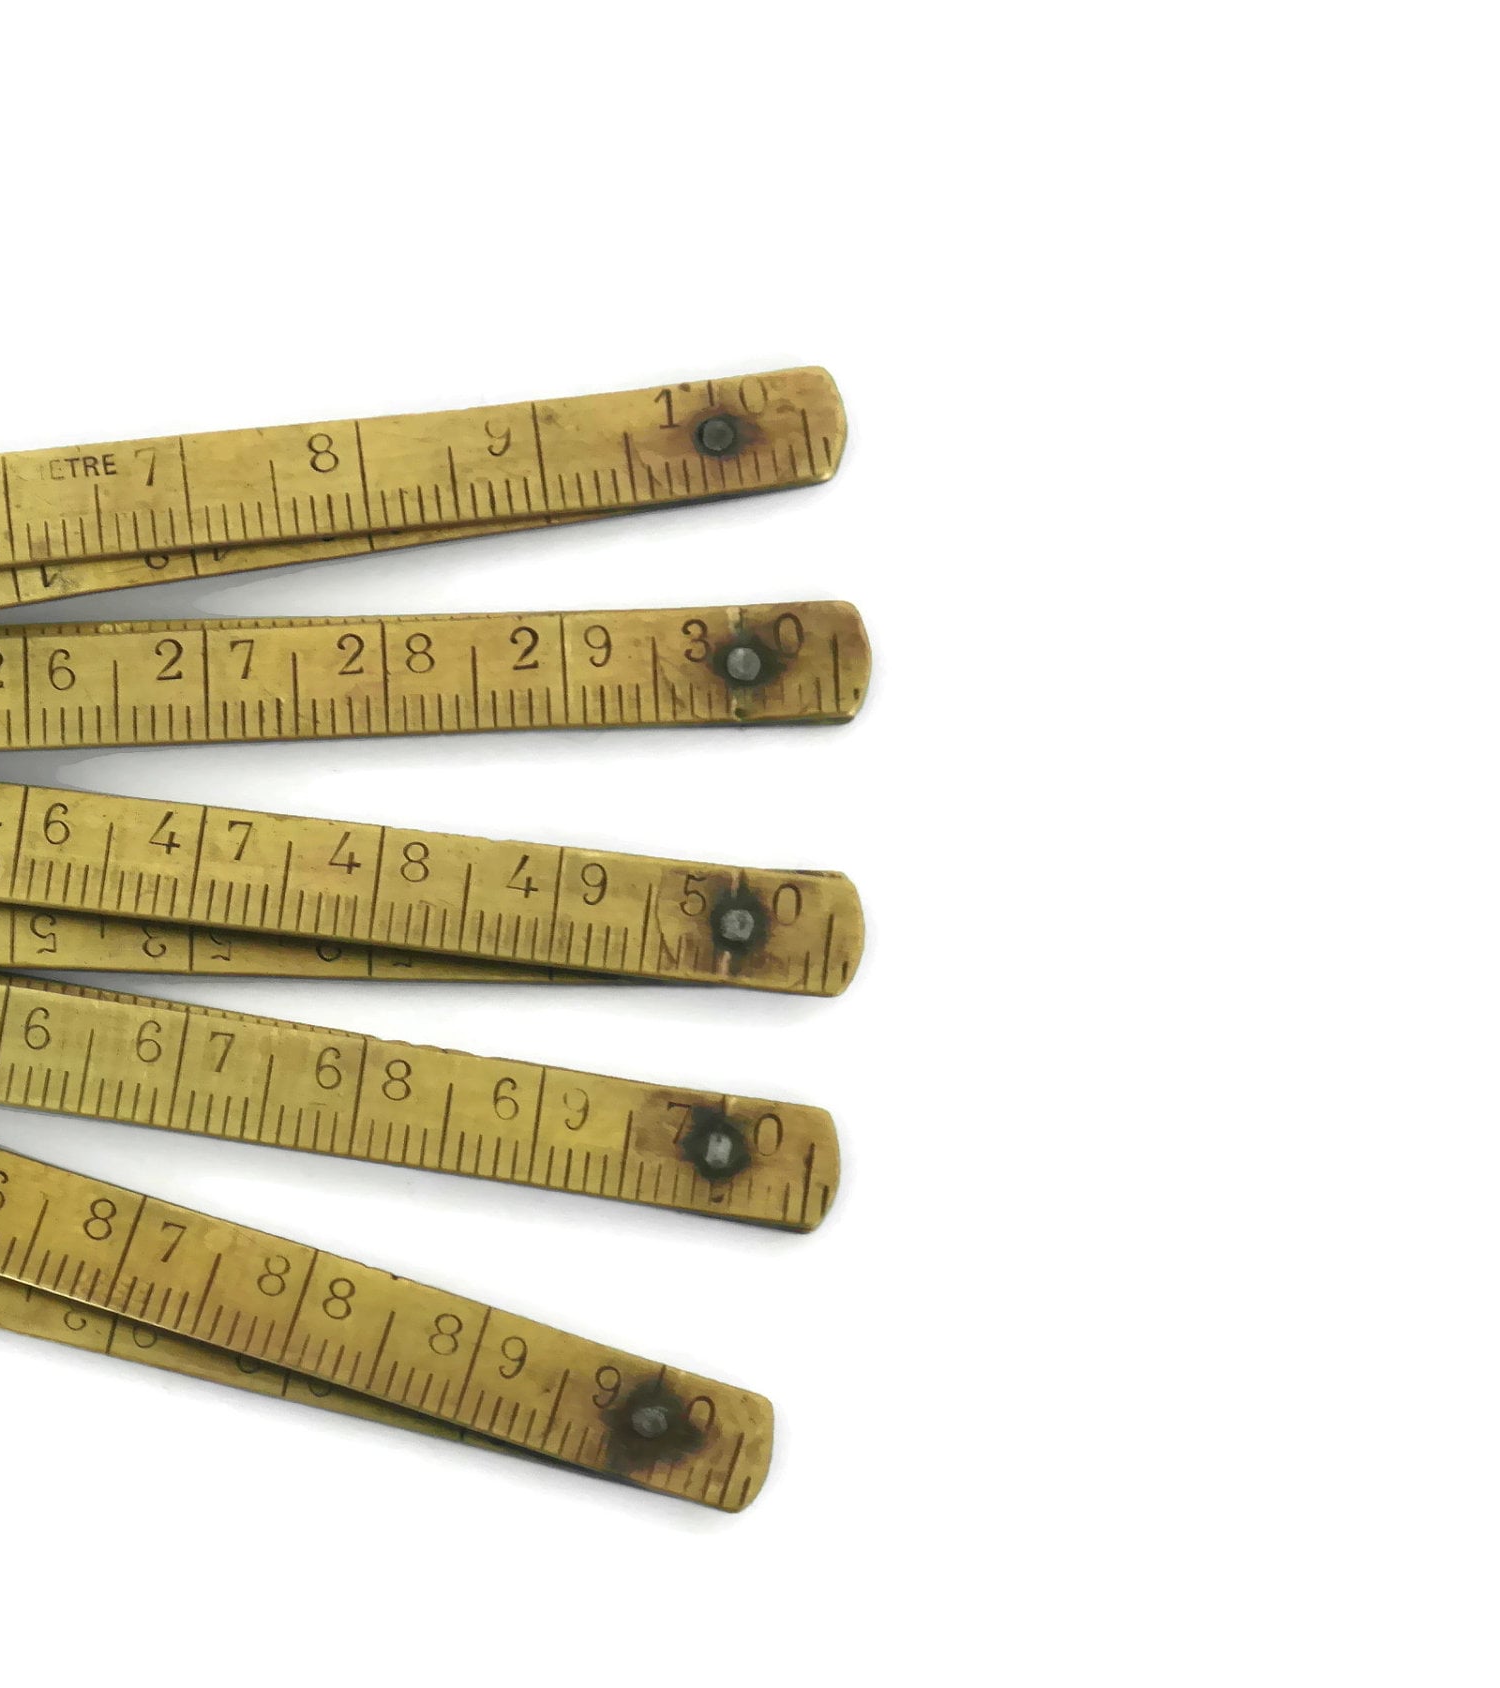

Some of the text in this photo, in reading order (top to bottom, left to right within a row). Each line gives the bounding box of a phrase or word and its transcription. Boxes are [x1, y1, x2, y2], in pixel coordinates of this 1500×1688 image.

[30, 453, 117, 482] ETRE
[134, 447, 160, 487] 7
[308, 433, 339, 473] 8
[484, 419, 512, 456] 9
[654, 388, 680, 429] 1
[739, 376, 768, 412] 0
[48, 649, 76, 692] 6
[155, 638, 184, 682] 2
[229, 638, 255, 680] 7
[337, 633, 366, 676] 2
[405, 633, 435, 674] 8
[510, 626, 540, 670] 2
[583, 625, 612, 668] 9
[681, 618, 709, 663] 3
[772, 612, 803, 655] 0
[43, 802, 71, 845] 6
[149, 811, 180, 854] 4
[228, 820, 253, 860] 7
[328, 831, 361, 874] 4
[400, 841, 429, 882] 8
[506, 854, 538, 898] 4
[581, 862, 608, 905] 9
[680, 873, 706, 916] 5
[773, 882, 802, 925] 0
[29, 912, 57, 954] 5
[24, 1006, 51, 1050] 6
[136, 1020, 162, 1063] 6
[209, 1031, 235, 1073] 7
[316, 1047, 342, 1090] 6
[381, 1059, 412, 1101] 8
[493, 1077, 519, 1120] 6
[562, 1088, 590, 1131] 9
[667, 1101, 692, 1145] 7
[753, 1113, 783, 1156] 0
[83, 1198, 116, 1240] 8
[160, 1221, 187, 1263] 7
[257, 1255, 291, 1296] 8
[322, 1277, 355, 1320] 8
[428, 1313, 463, 1356] 8
[499, 1336, 528, 1379] 9
[592, 1365, 621, 1409] 9
